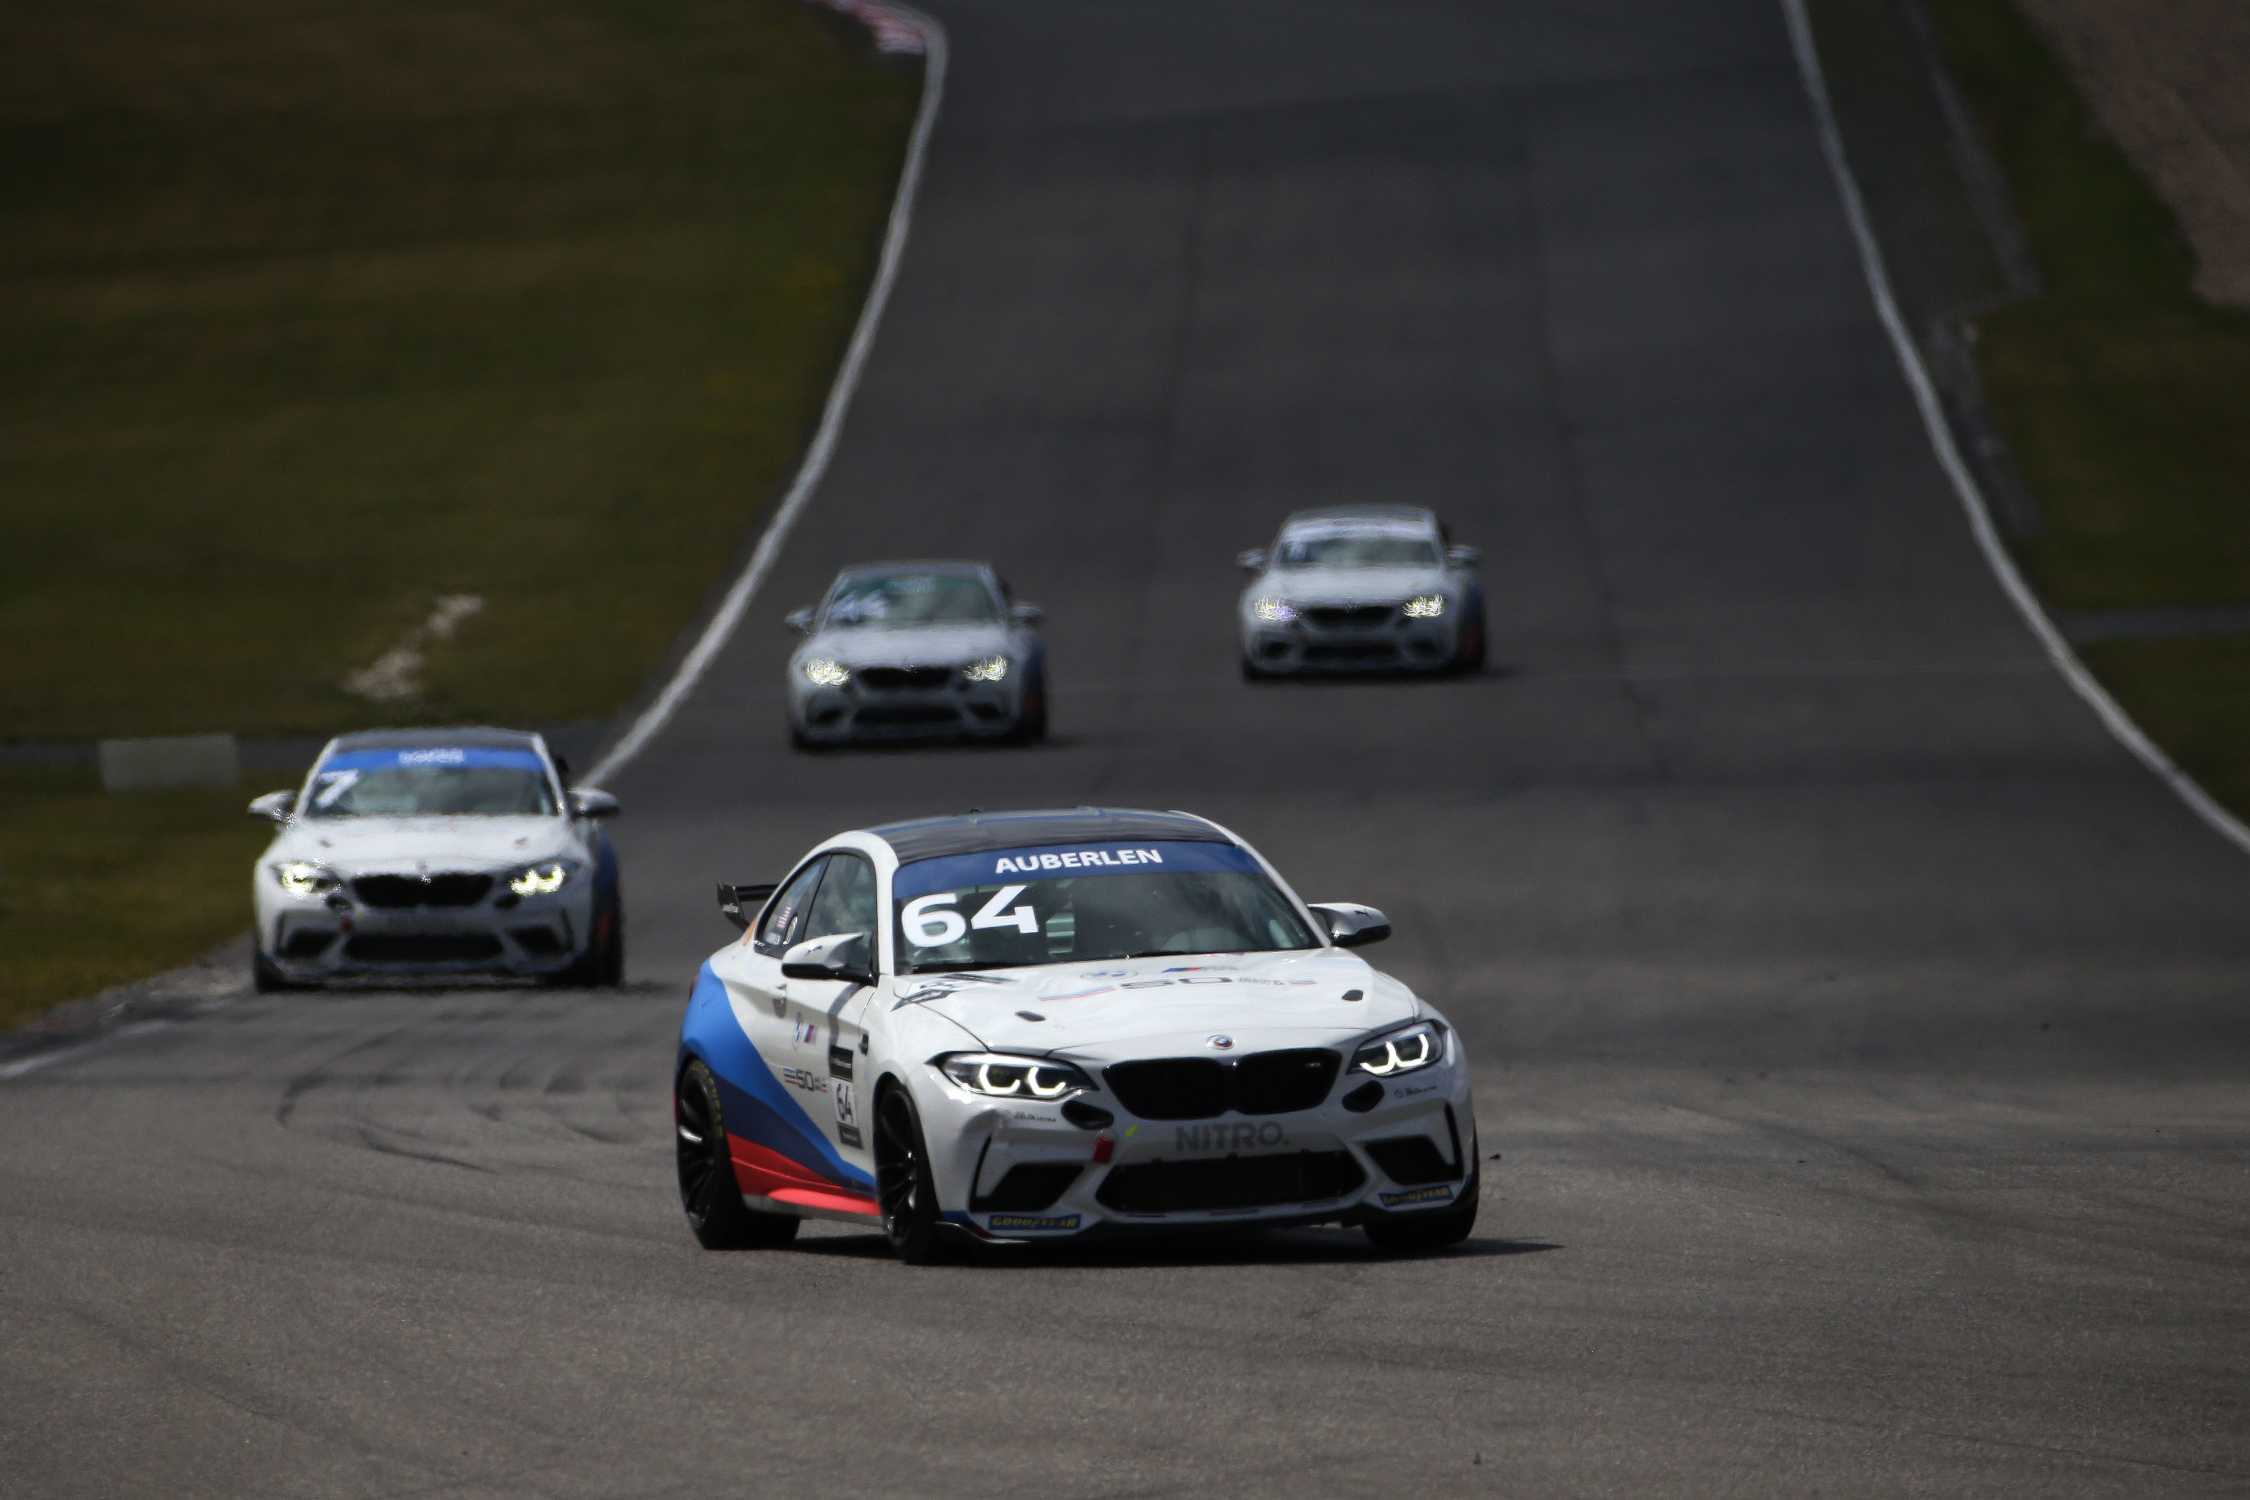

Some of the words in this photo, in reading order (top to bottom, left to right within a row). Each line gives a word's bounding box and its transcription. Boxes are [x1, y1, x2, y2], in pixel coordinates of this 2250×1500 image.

[319, 769, 359, 808] 7
[995, 849, 1163, 874] AUBERLEN
[901, 885, 1039, 948] 64
[836, 1083, 854, 1124] 64
